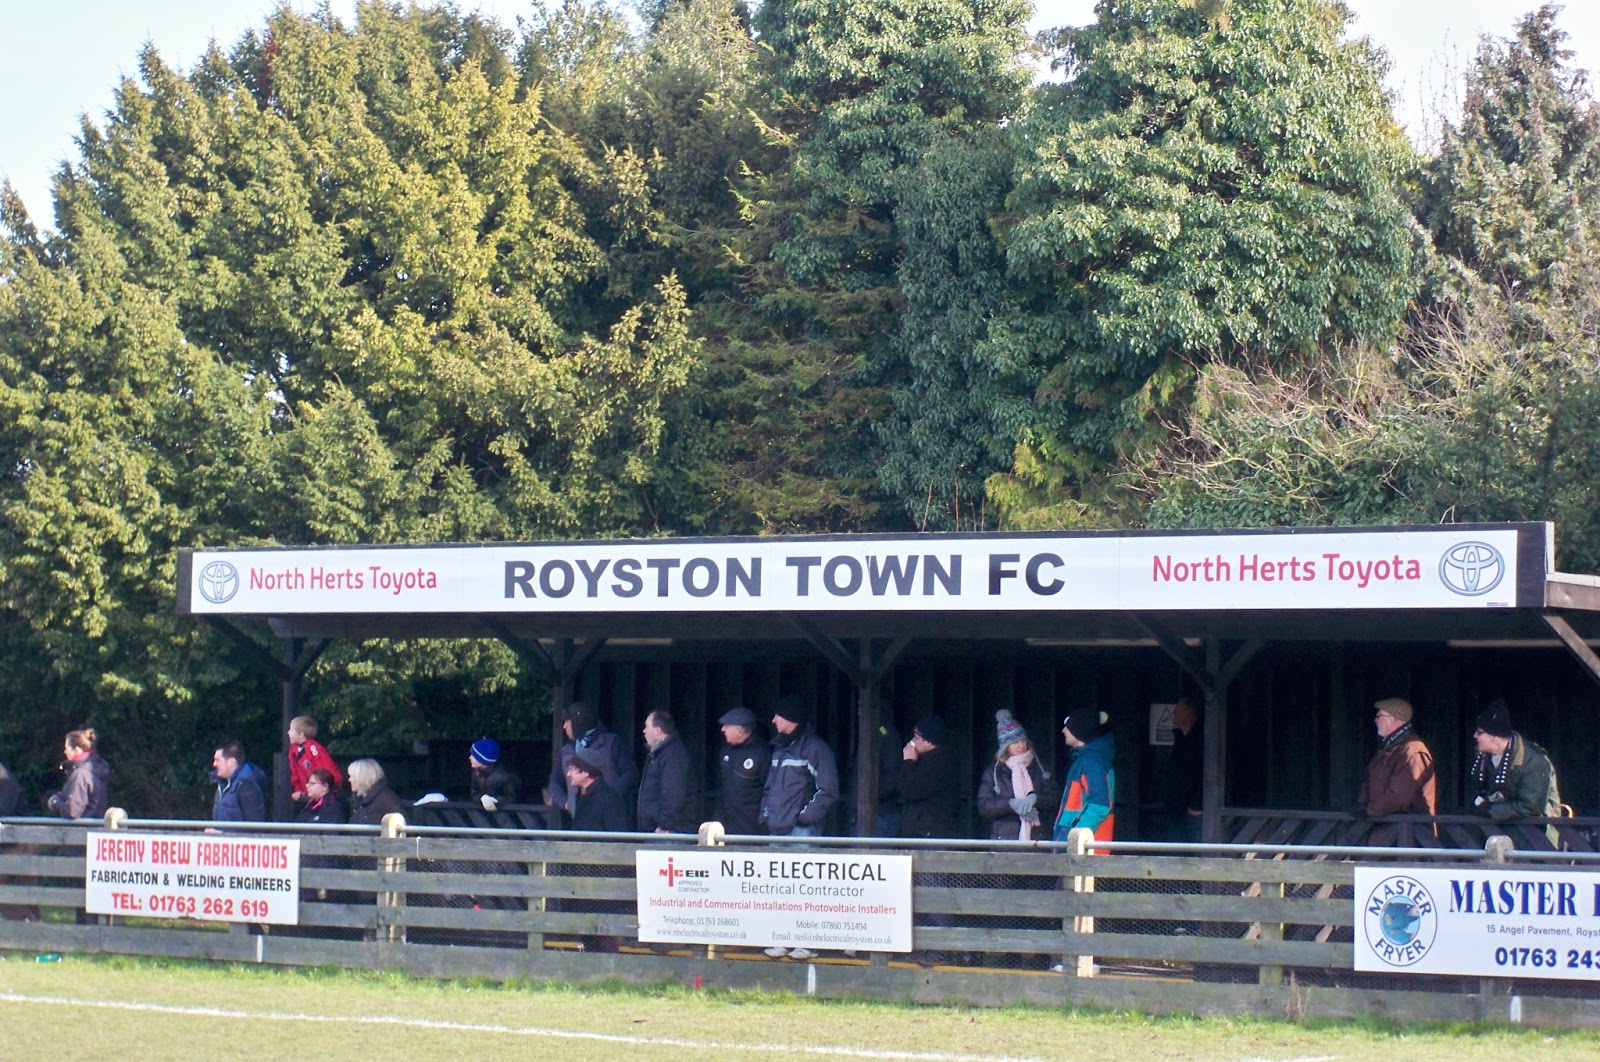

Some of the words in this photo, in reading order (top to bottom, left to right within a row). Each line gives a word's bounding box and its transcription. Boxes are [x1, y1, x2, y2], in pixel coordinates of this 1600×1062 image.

[249, 566, 304, 590] North
[310, 566, 364, 590] Herts
[369, 565, 438, 595] Toyota
[504, 556, 762, 599] ROYSTON
[786, 554, 962, 597] TOWN
[988, 552, 1066, 596] FC
[1153, 554, 1231, 582] North
[1239, 554, 1316, 582] Herts
[1322, 553, 1421, 589] Toyota
[96, 838, 145, 863] JEREMY
[151, 840, 191, 865] BREW
[197, 842, 288, 869] FABRICATIONS
[91, 870, 158, 886] FABRICATION
[163, 873, 170, 886] &
[177, 873, 225, 889] WELDING
[229, 876, 292, 892] ENGINEERS
[721, 859, 761, 878] N.B.
[769, 861, 887, 881] ELECTRICAL
[741, 881, 795, 895] Electrical
[799, 883, 865, 897] Contractor
[1368, 880, 1432, 917] MASTER
[1449, 879, 1577, 917] MASTER
[111, 892, 142, 910] TEL:
[149, 895, 196, 913] 01763
[203, 897, 233, 915] 262
[240, 899, 269, 917] 619
[649, 897, 686, 907] Industrial
[688, 899, 702, 908] and
[704, 899, 751, 910] Commercial
[753, 900, 802, 911] Installations
[804, 902, 856, 913] Photovoltaic
[858, 904, 897, 915] Installers
[1486, 924, 1496, 933] 15
[1499, 925, 1525, 936] Angel
[1527, 925, 1572, 936] Pavement,
[1375, 938, 1425, 962] FRYER
[1495, 947, 1557, 968] 01763
